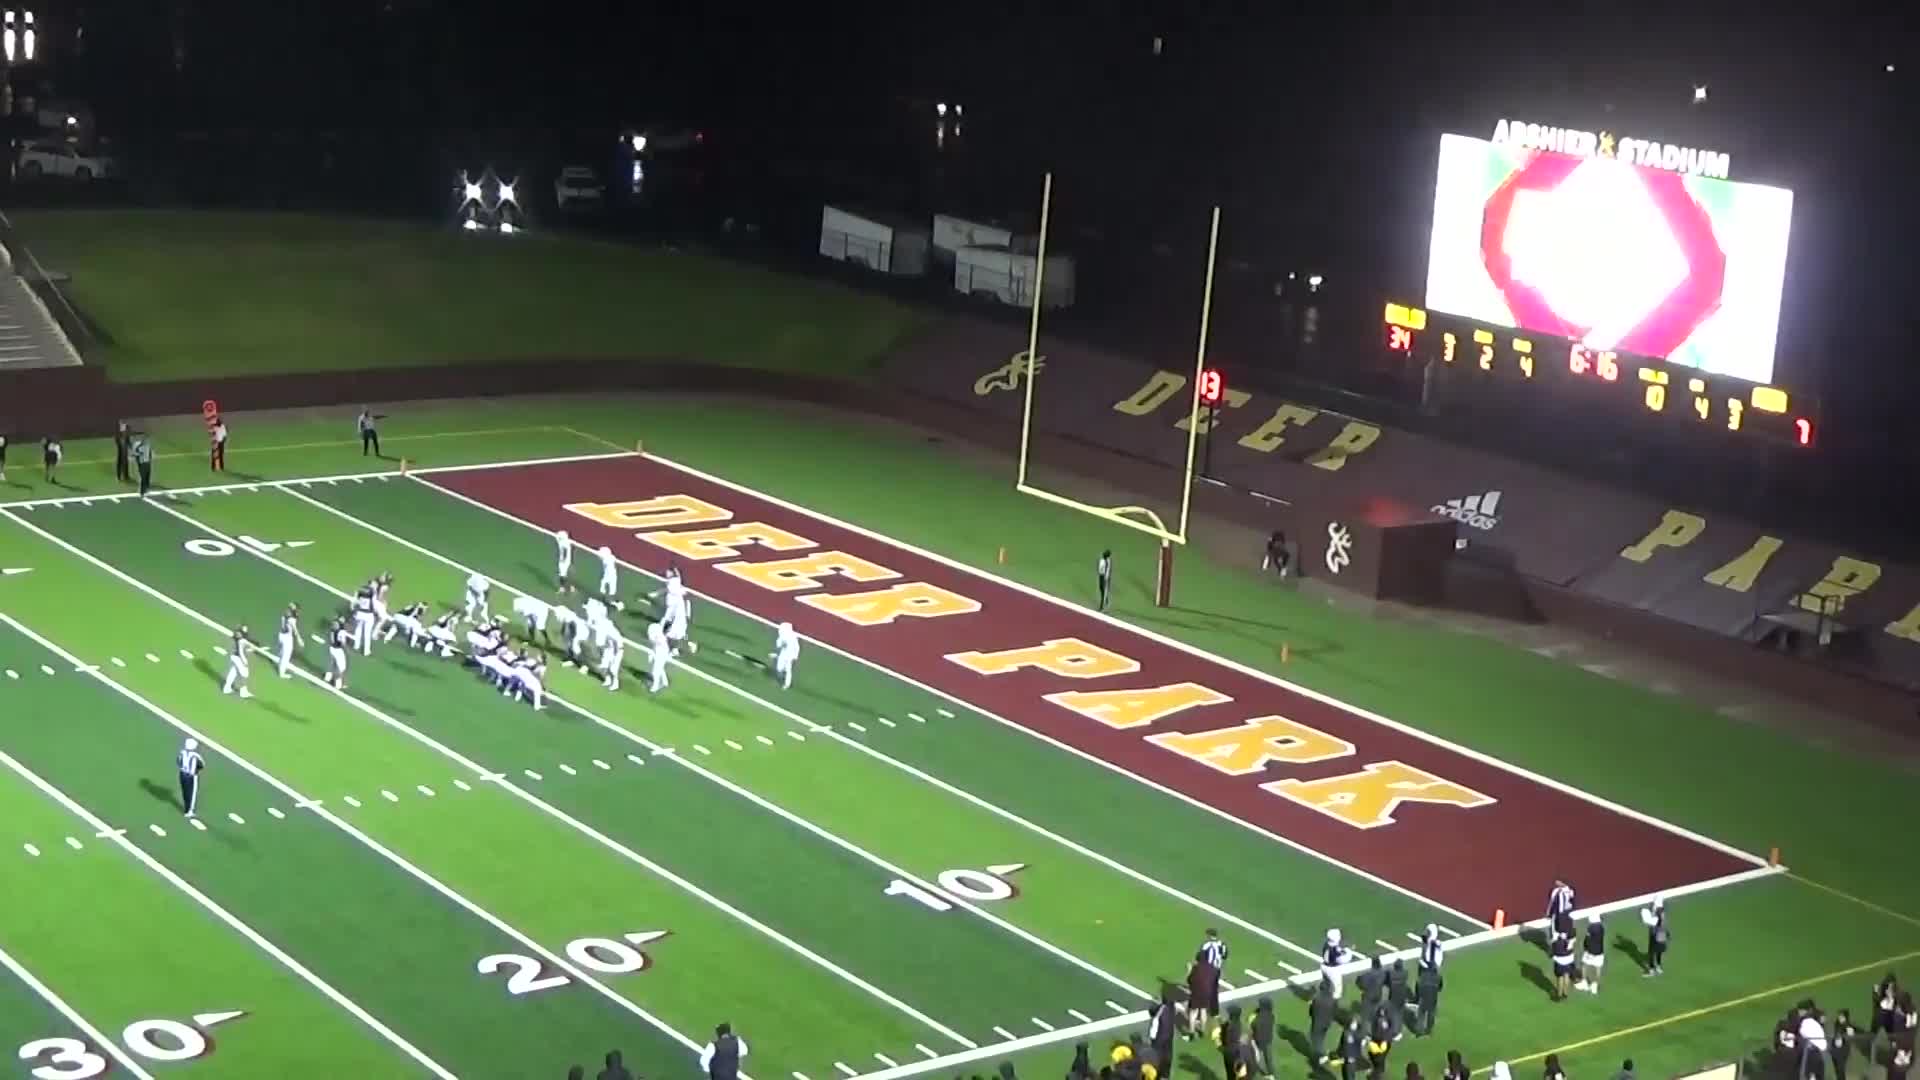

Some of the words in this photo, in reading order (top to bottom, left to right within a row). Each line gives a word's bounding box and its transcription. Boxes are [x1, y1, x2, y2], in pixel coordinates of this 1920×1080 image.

[1616, 137, 1730, 179] STADIUM
[1389, 321, 1411, 350] 34
[1479, 345, 1494, 370] 2
[1519, 356, 1533, 378] 4
[1569, 343, 1618, 381] 6:16
[1200, 371, 1221, 400] 13
[562, 494, 983, 626] DEER
[944, 637, 1497, 829] PARK
[884, 868, 1013, 911] 10
[477, 937, 646, 995] 20
[18, 1018, 209, 1080] 30
